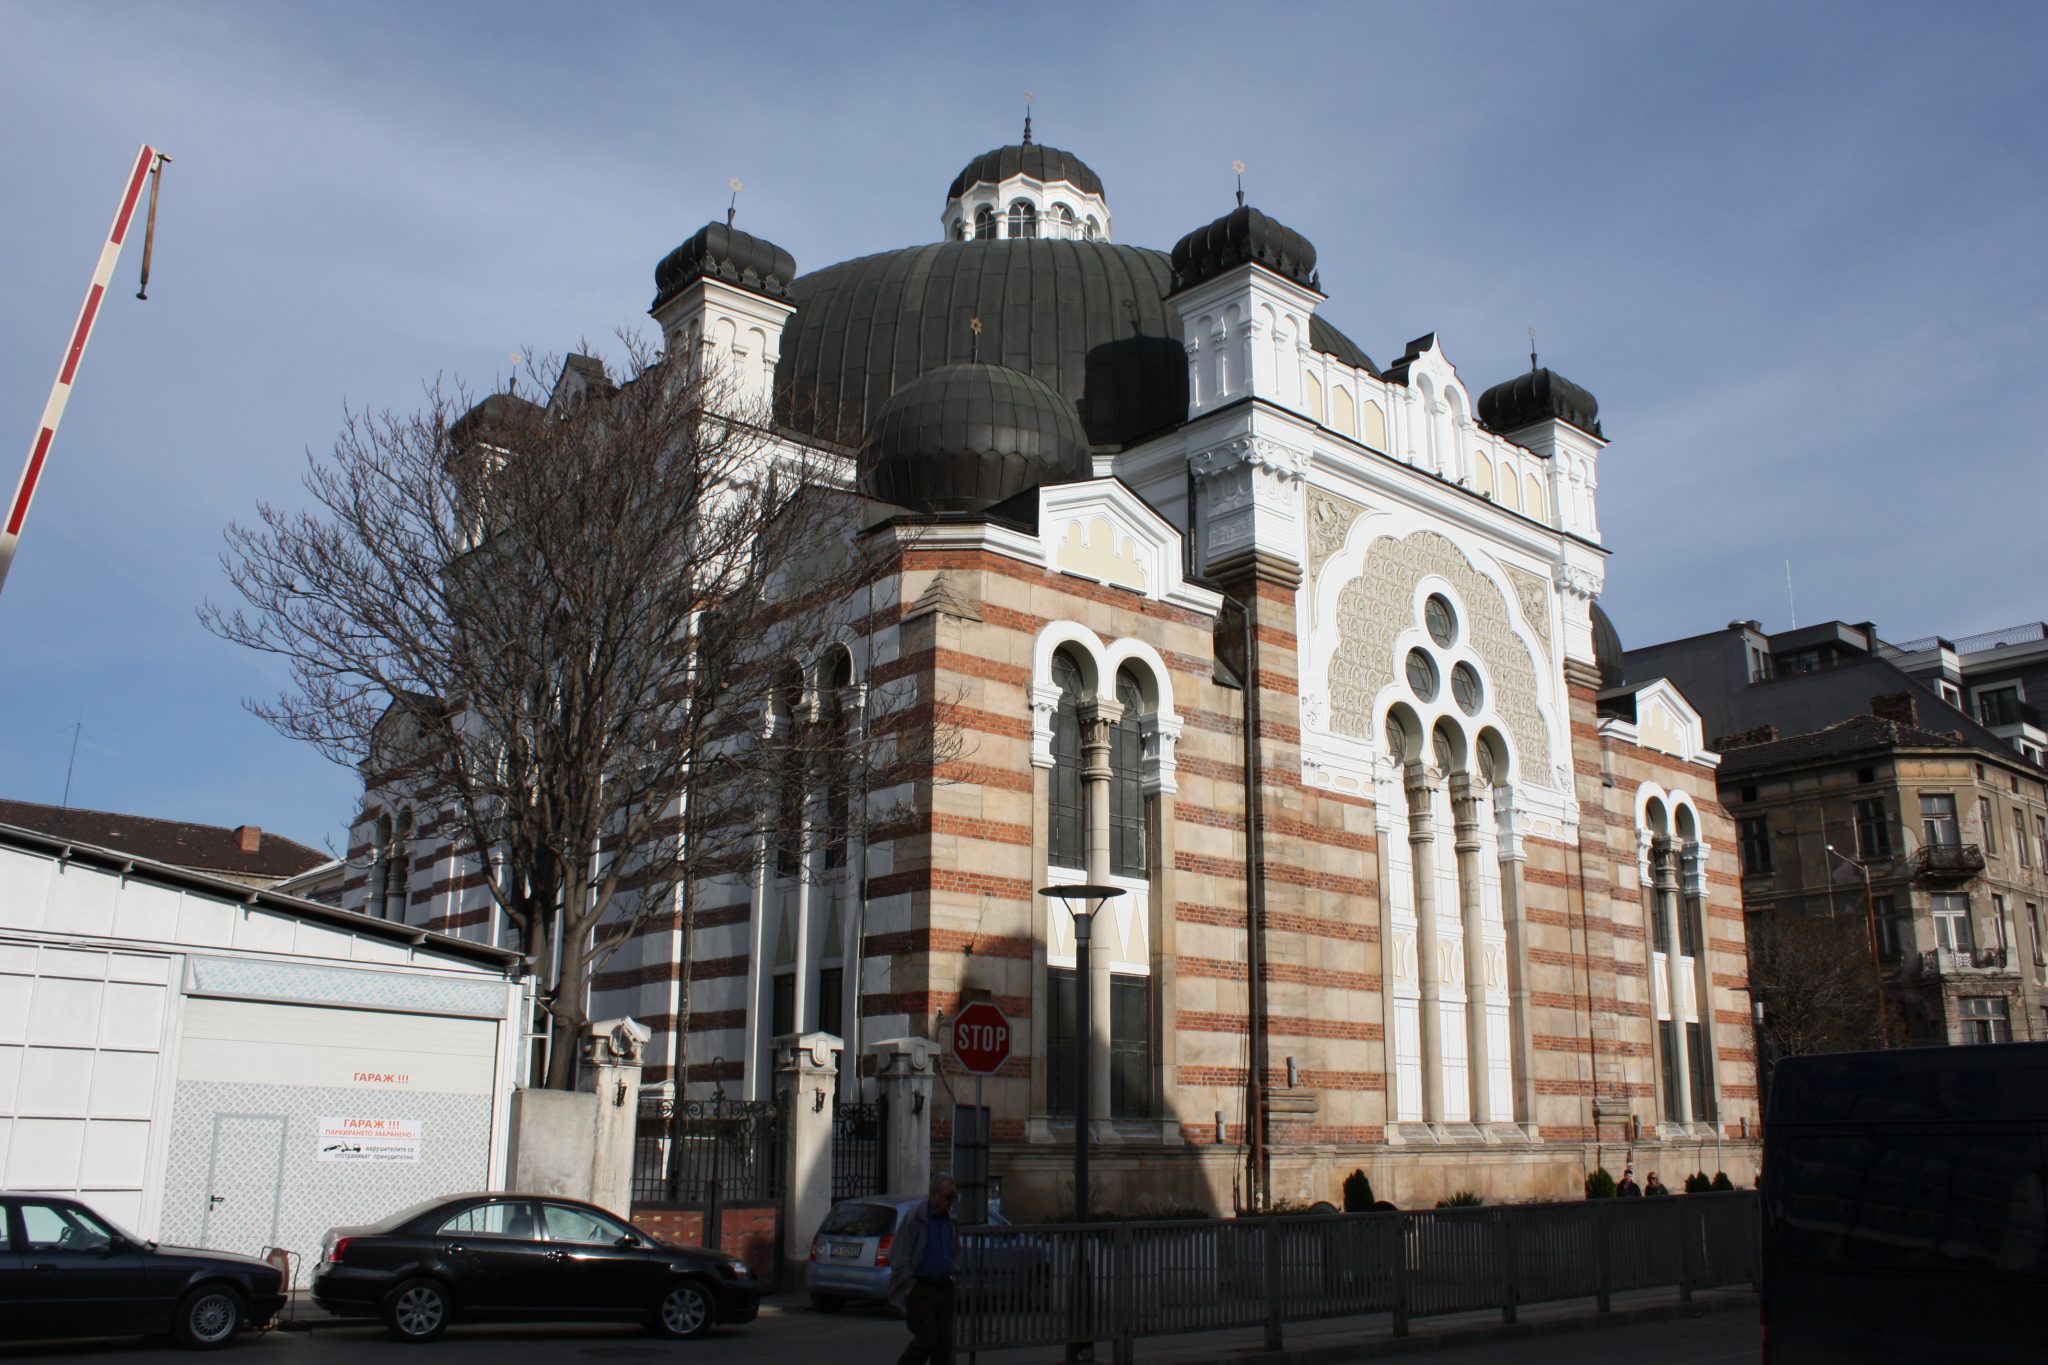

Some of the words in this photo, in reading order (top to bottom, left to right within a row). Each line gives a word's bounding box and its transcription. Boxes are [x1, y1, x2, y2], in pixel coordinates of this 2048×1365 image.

[958, 1023, 1006, 1052] STOP
[353, 1072, 394, 1083] ГАРАЖ
[398, 1075, 409, 1083] !!!
[343, 1119, 384, 1129] ГАРАЖ
[388, 1121, 400, 1129] !!!
[325, 1129, 373, 1137] ПАРКИРАНЕТО
[374, 1130, 412, 1138] ЗАБРАНЕНО
